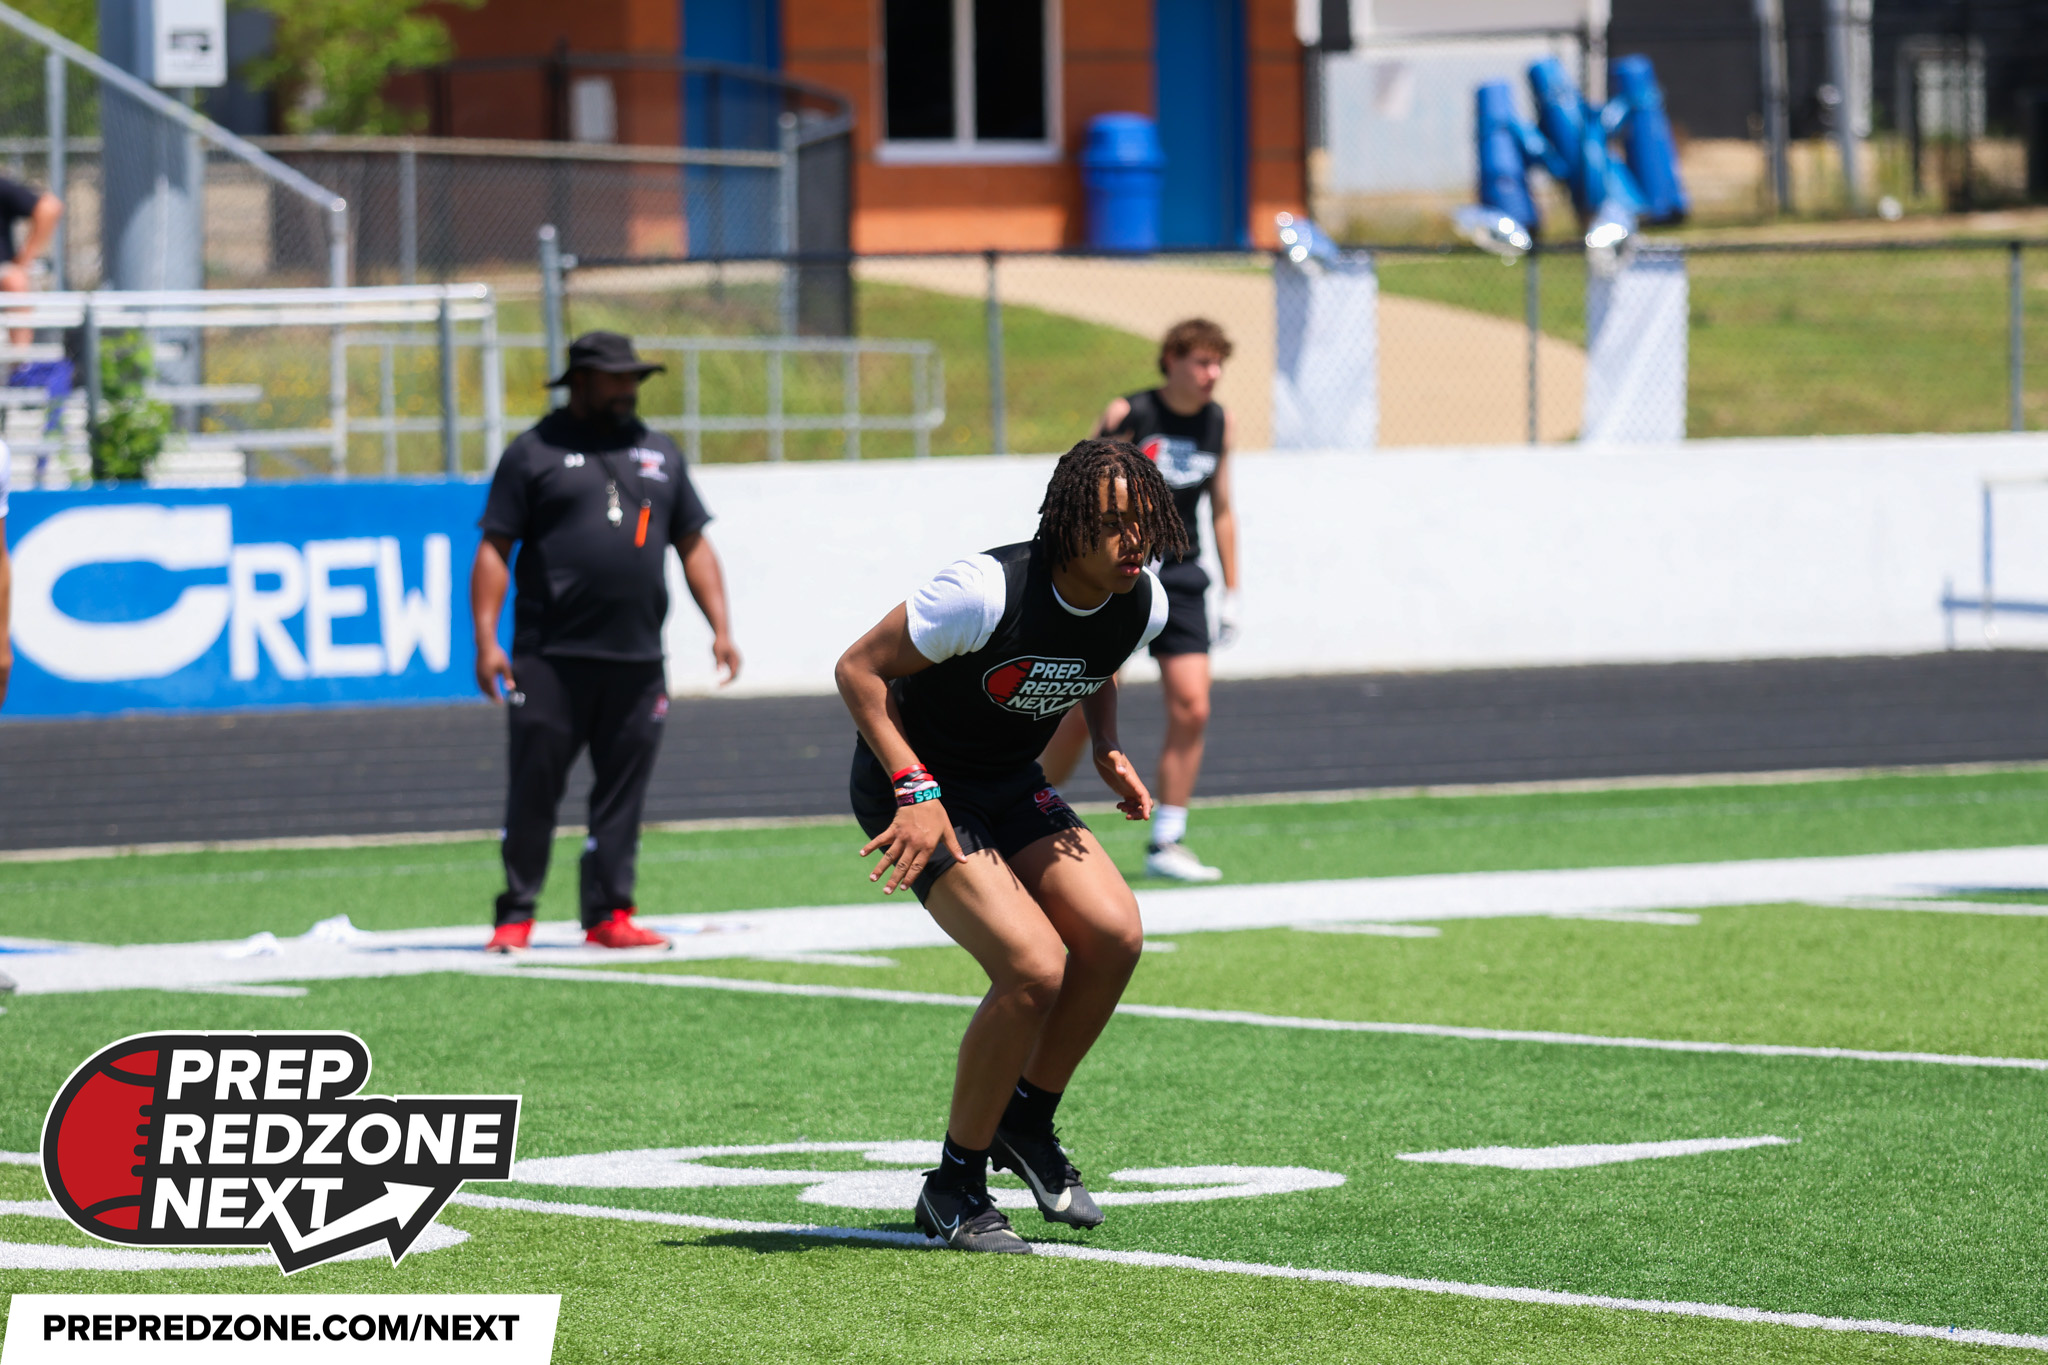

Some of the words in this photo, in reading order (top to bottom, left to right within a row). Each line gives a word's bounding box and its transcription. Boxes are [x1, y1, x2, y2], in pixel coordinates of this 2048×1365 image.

[10, 502, 452, 684] CREW
[1029, 662, 1082, 679] PREP
[1006, 695, 1064, 713] NEXT
